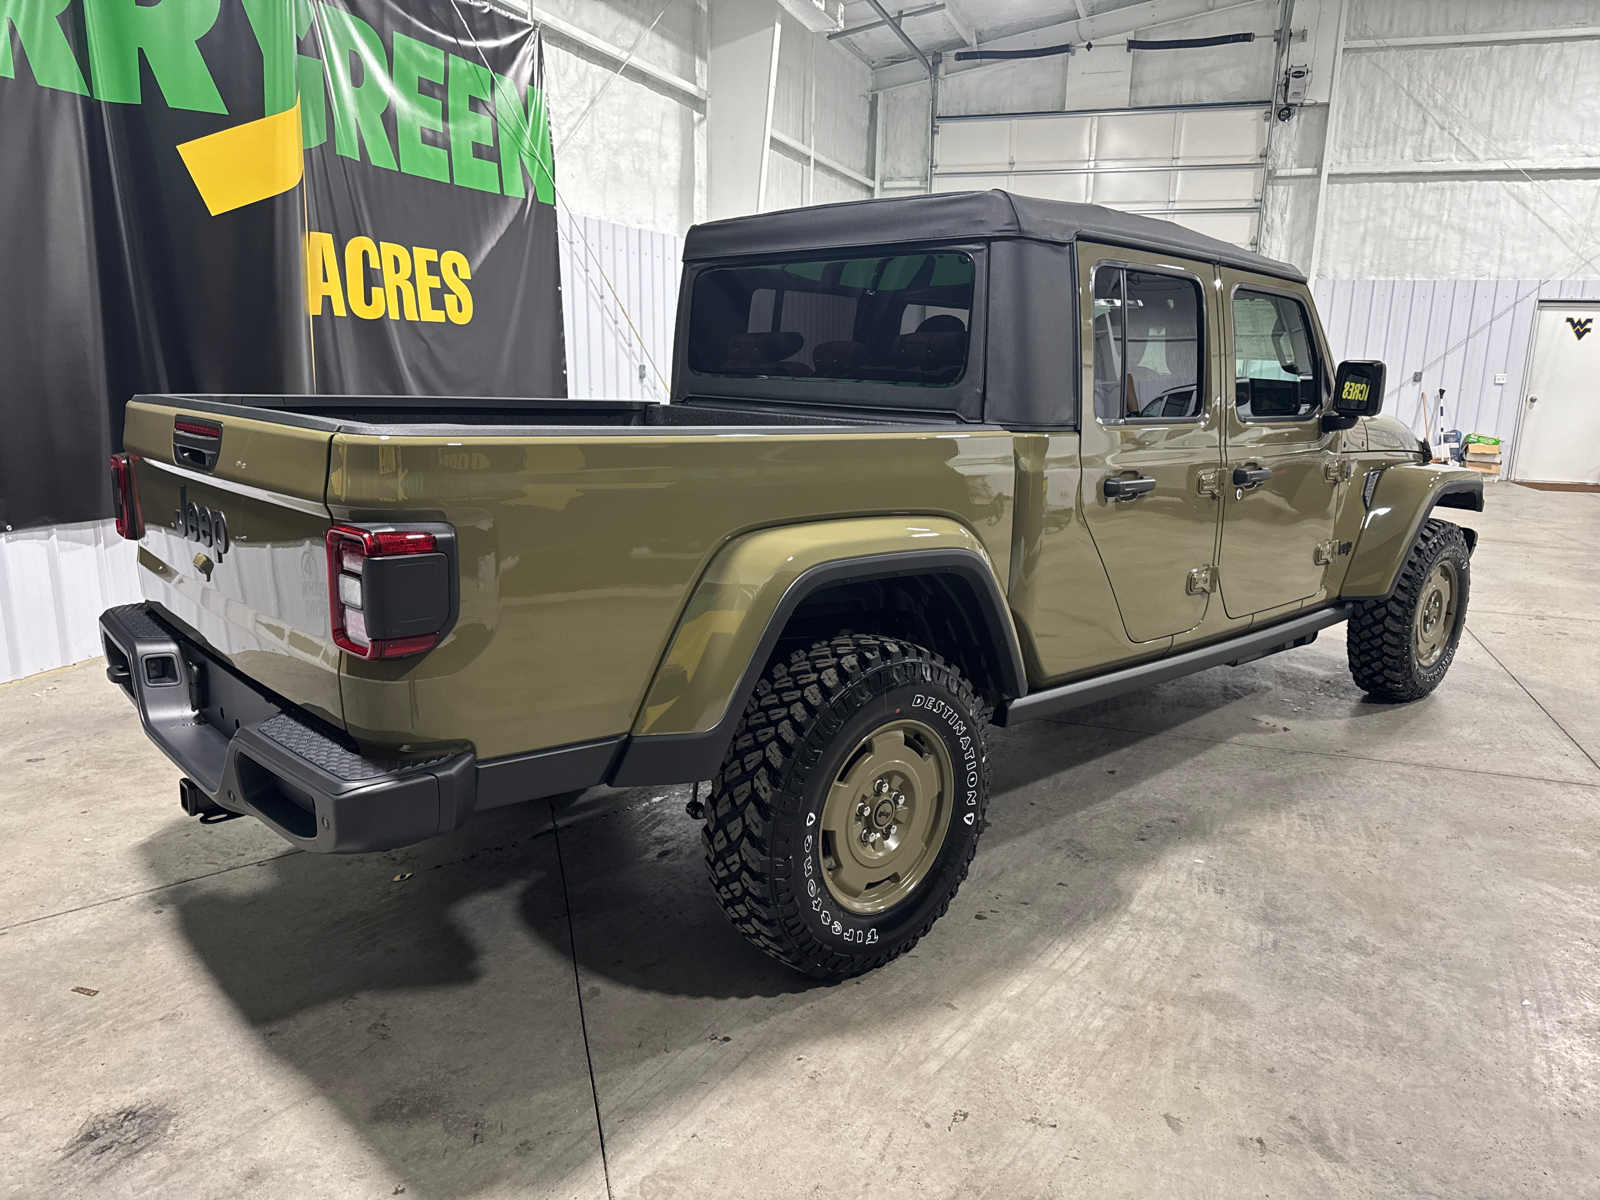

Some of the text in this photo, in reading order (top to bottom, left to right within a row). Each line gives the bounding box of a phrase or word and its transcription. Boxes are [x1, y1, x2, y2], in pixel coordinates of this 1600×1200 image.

[307, 230, 474, 325] ACRES
[174, 484, 230, 564] Jeep
[911, 694, 978, 806] DESTINATION
